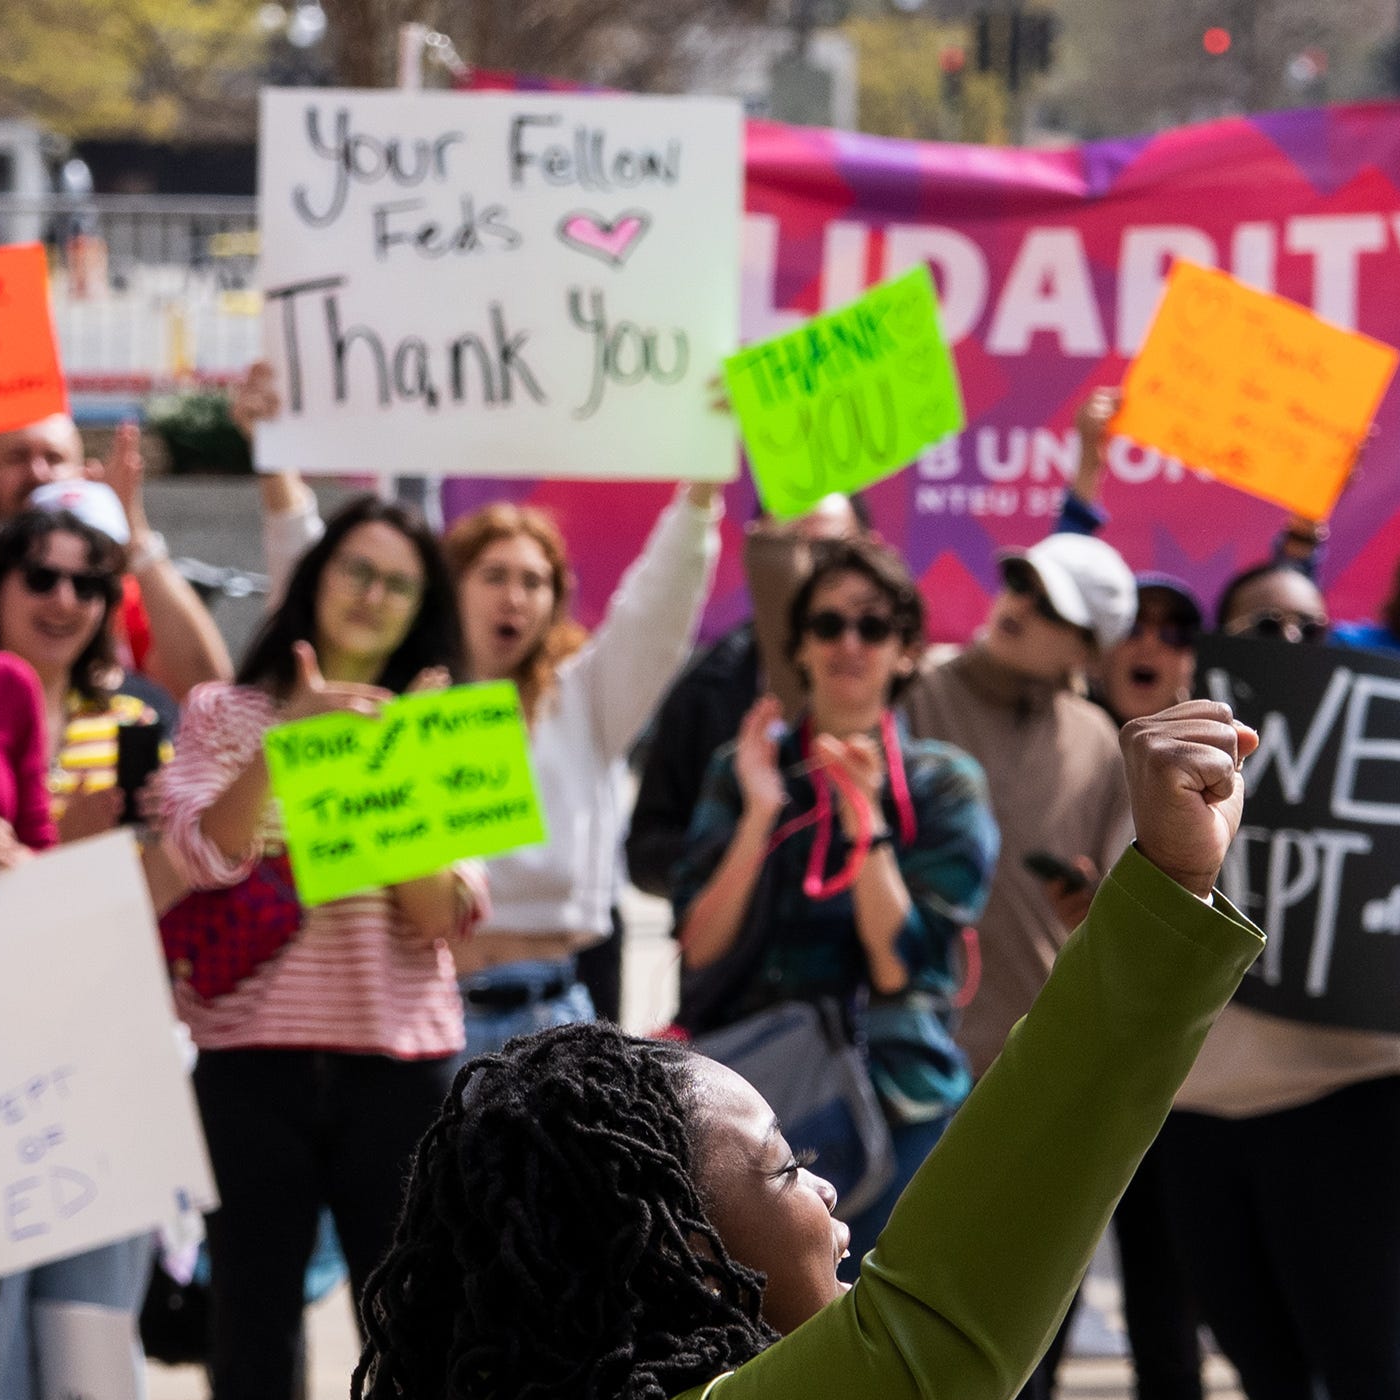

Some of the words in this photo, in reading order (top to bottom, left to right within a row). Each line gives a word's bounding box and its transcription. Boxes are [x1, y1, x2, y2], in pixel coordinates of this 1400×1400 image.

[291, 104, 466, 228] Your
[372, 192, 523, 262] Feds
[265, 273, 548, 415] Thank
[733, 304, 898, 408] THANK
[1219, 825, 1373, 997] EPT
[4, 1164, 99, 1242] ED
